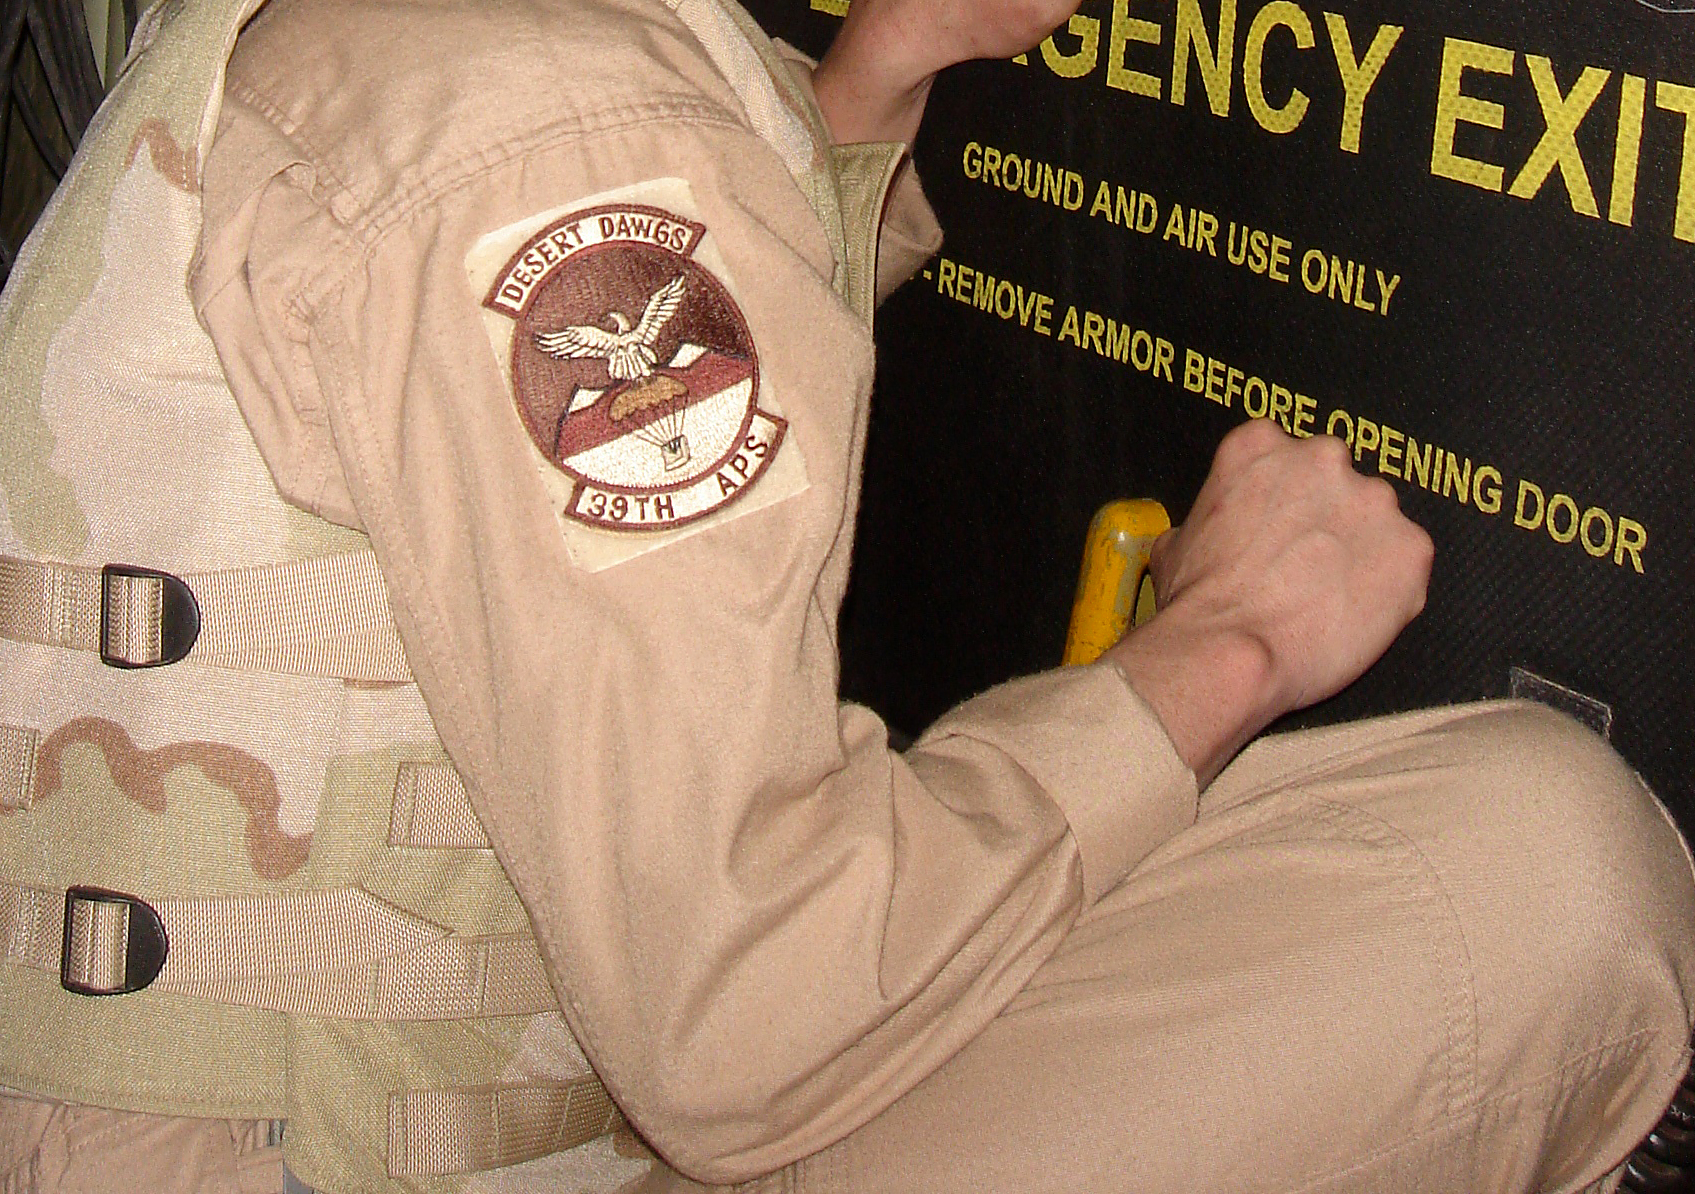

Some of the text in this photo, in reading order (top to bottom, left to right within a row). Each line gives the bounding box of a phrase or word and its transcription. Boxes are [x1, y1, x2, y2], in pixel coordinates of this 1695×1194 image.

[1430, 36, 1695, 244] EXIT
[501, 215, 688, 302] DESERT DAWGS
[962, 141, 1401, 316] GROUND AND AIR USE ONLY
[586, 434, 768, 520] 39TH APS
[937, 258, 1054, 336] REMOVE
[1057, 305, 1175, 383] ARMOR
[1183, 348, 1317, 438] BEFORE
[1326, 409, 1503, 514] OPENING
[1513, 479, 1648, 575] DOOR
